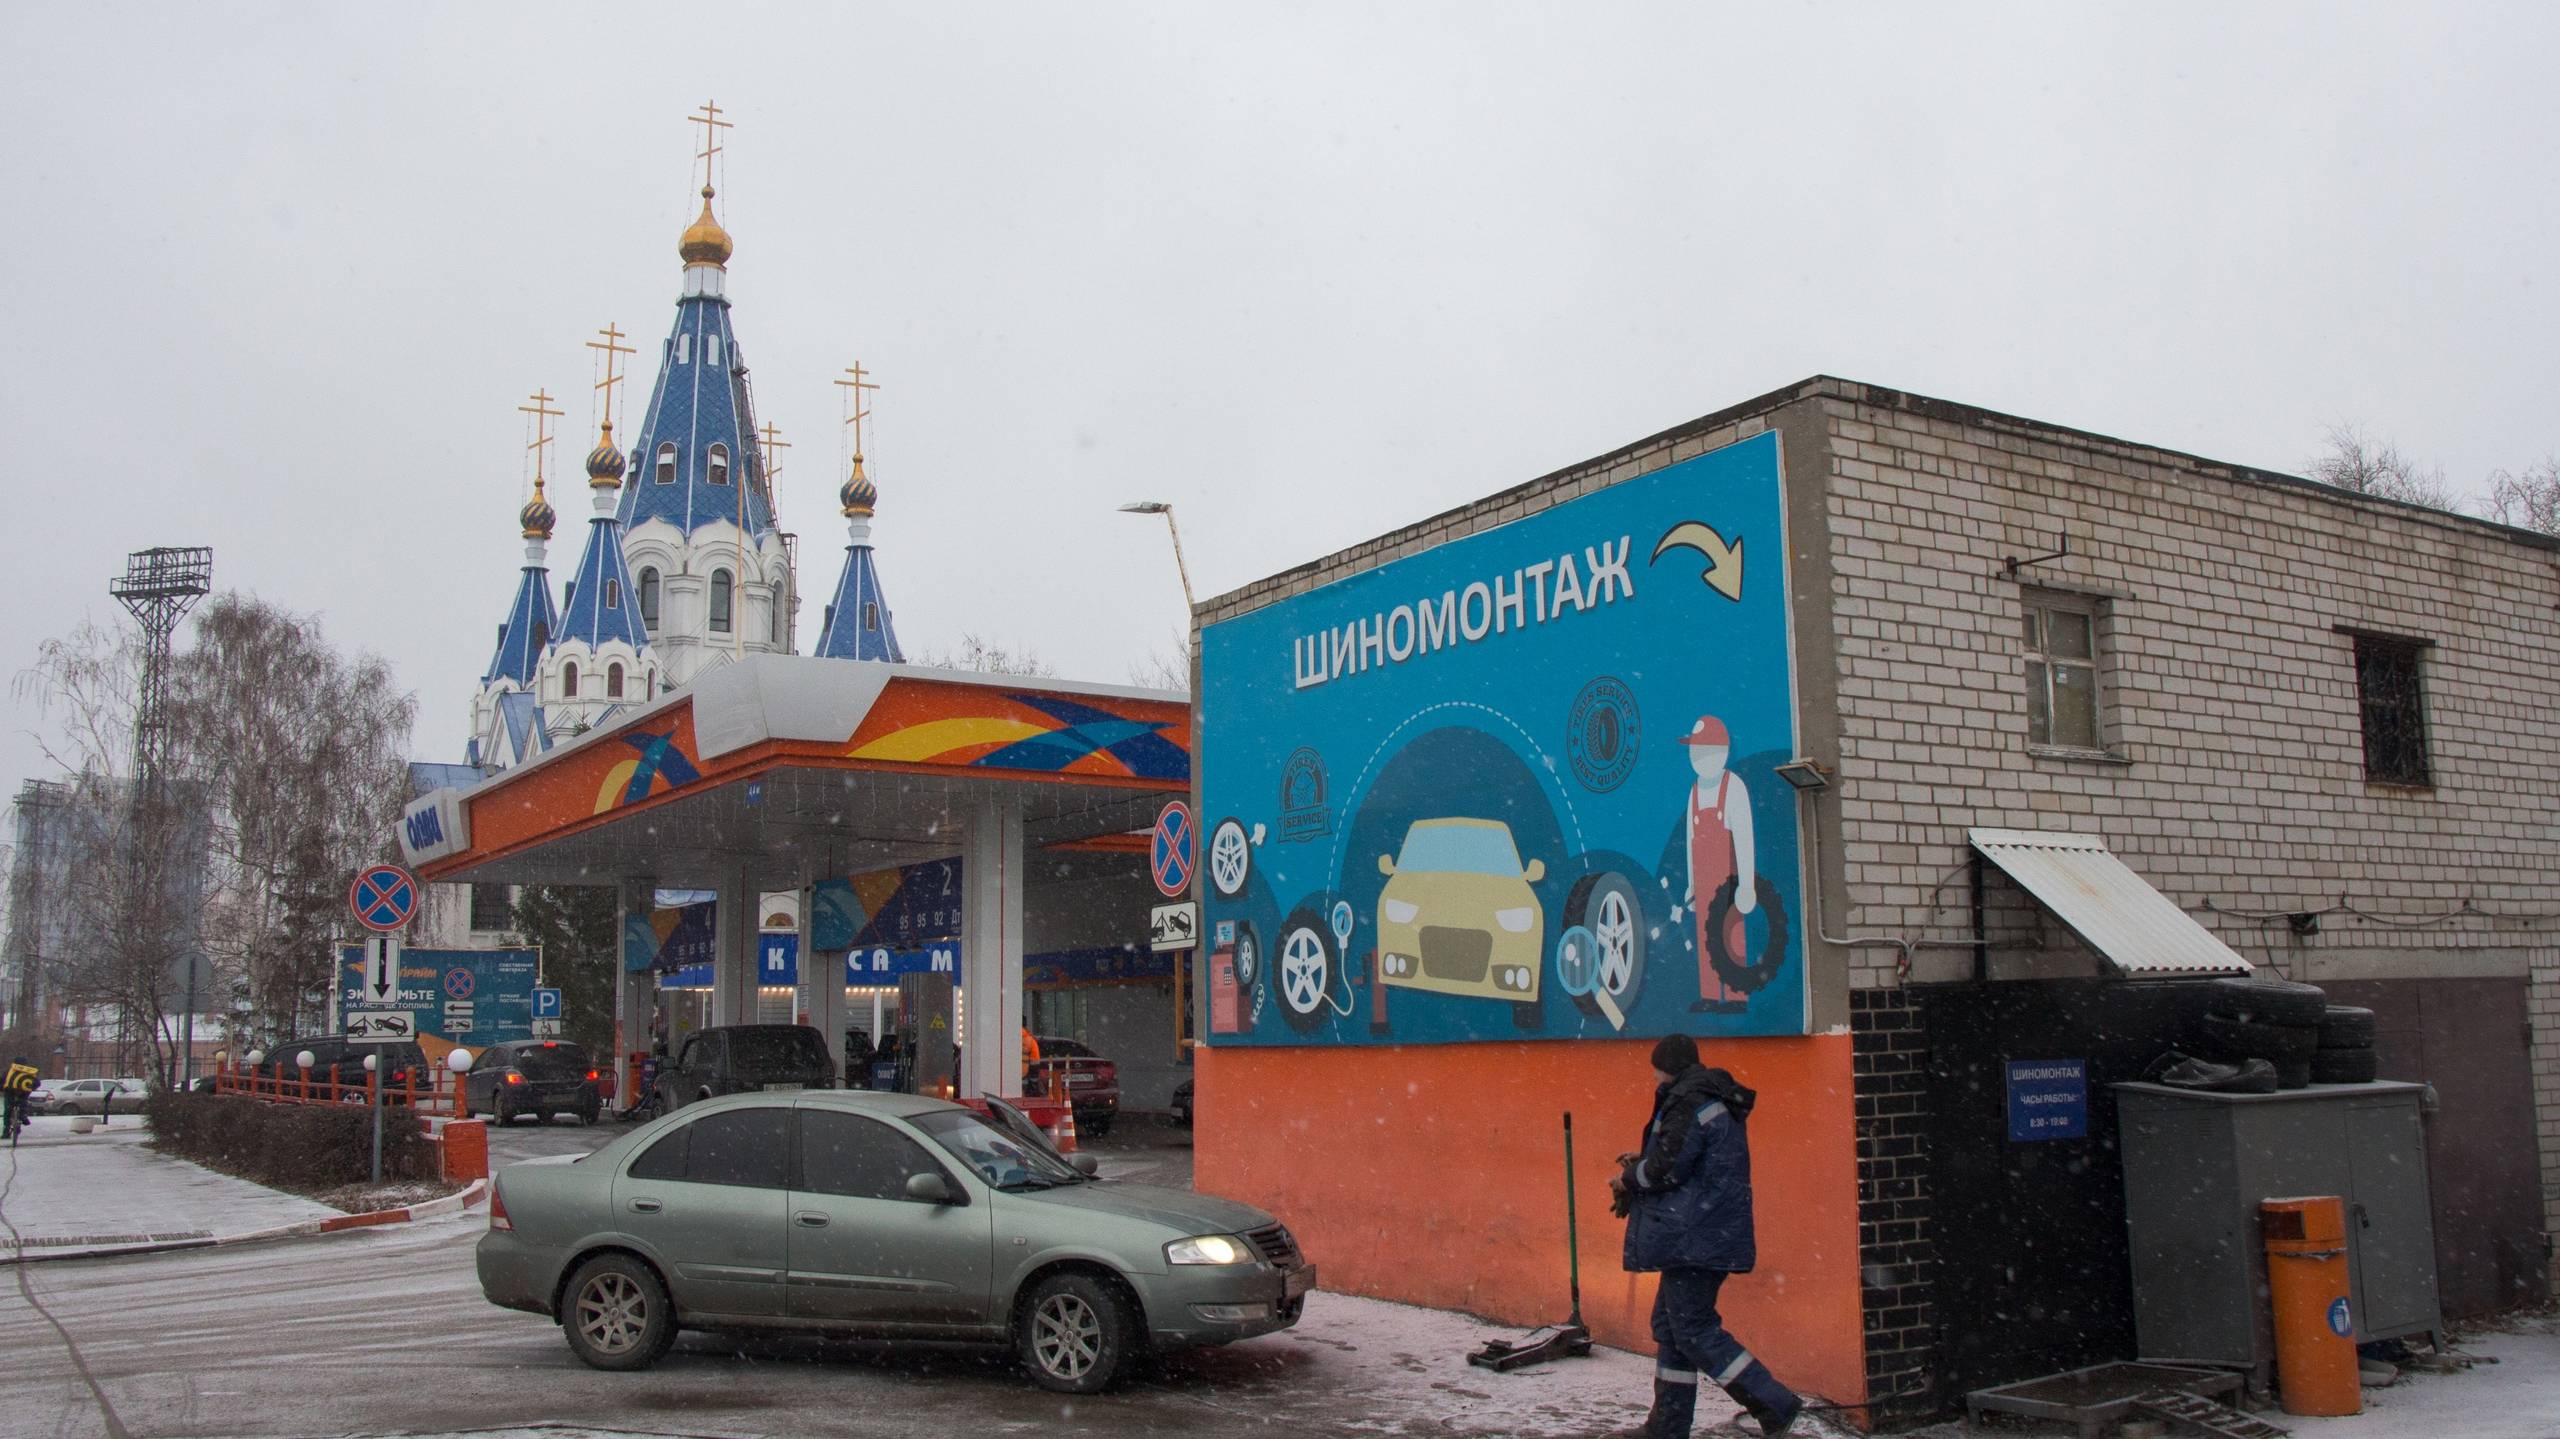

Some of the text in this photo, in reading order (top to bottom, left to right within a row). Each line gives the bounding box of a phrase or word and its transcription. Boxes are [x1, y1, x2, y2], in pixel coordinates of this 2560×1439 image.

[1295, 536, 1633, 688] ШИНОМОНТАЖ
[1596, 684, 1632, 716] SERVICE
[1598, 745, 1633, 785] QUALITY
[1285, 811, 1323, 829] SERVICE
[942, 862, 952, 896] 2
[899, 914, 909, 930] 95
[917, 912, 926, 928] 95
[934, 911, 944, 926] 92
[347, 989, 435, 1000] ЭКМЬТЕ
[2013, 1067, 2080, 1080] ШИНОМОНТАЖ
[2021, 1095, 2043, 1104] ЧАСЫ
